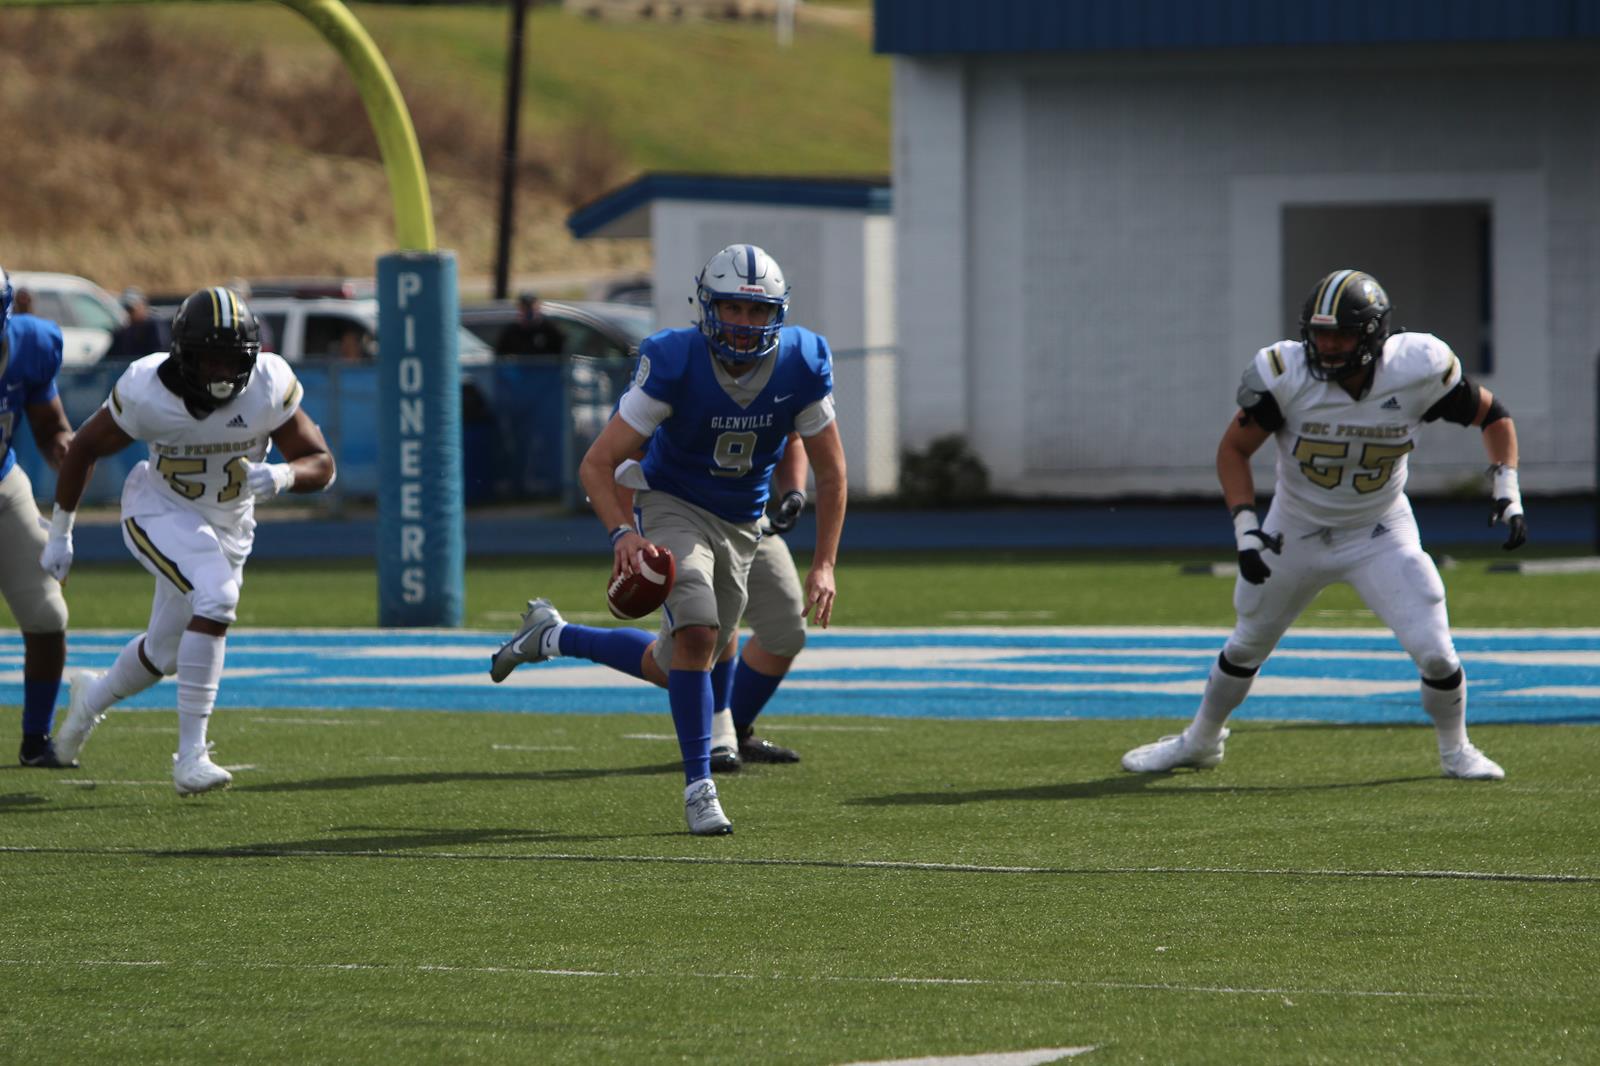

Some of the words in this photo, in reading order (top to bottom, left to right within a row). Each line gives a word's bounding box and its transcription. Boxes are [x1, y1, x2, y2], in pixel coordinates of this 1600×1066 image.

[397, 271, 426, 604] PIONEERS
[711, 413, 774, 430] GLENVILLE
[156, 454, 249, 503] 51
[709, 430, 758, 478] 9
[1292, 435, 1415, 495] 55
